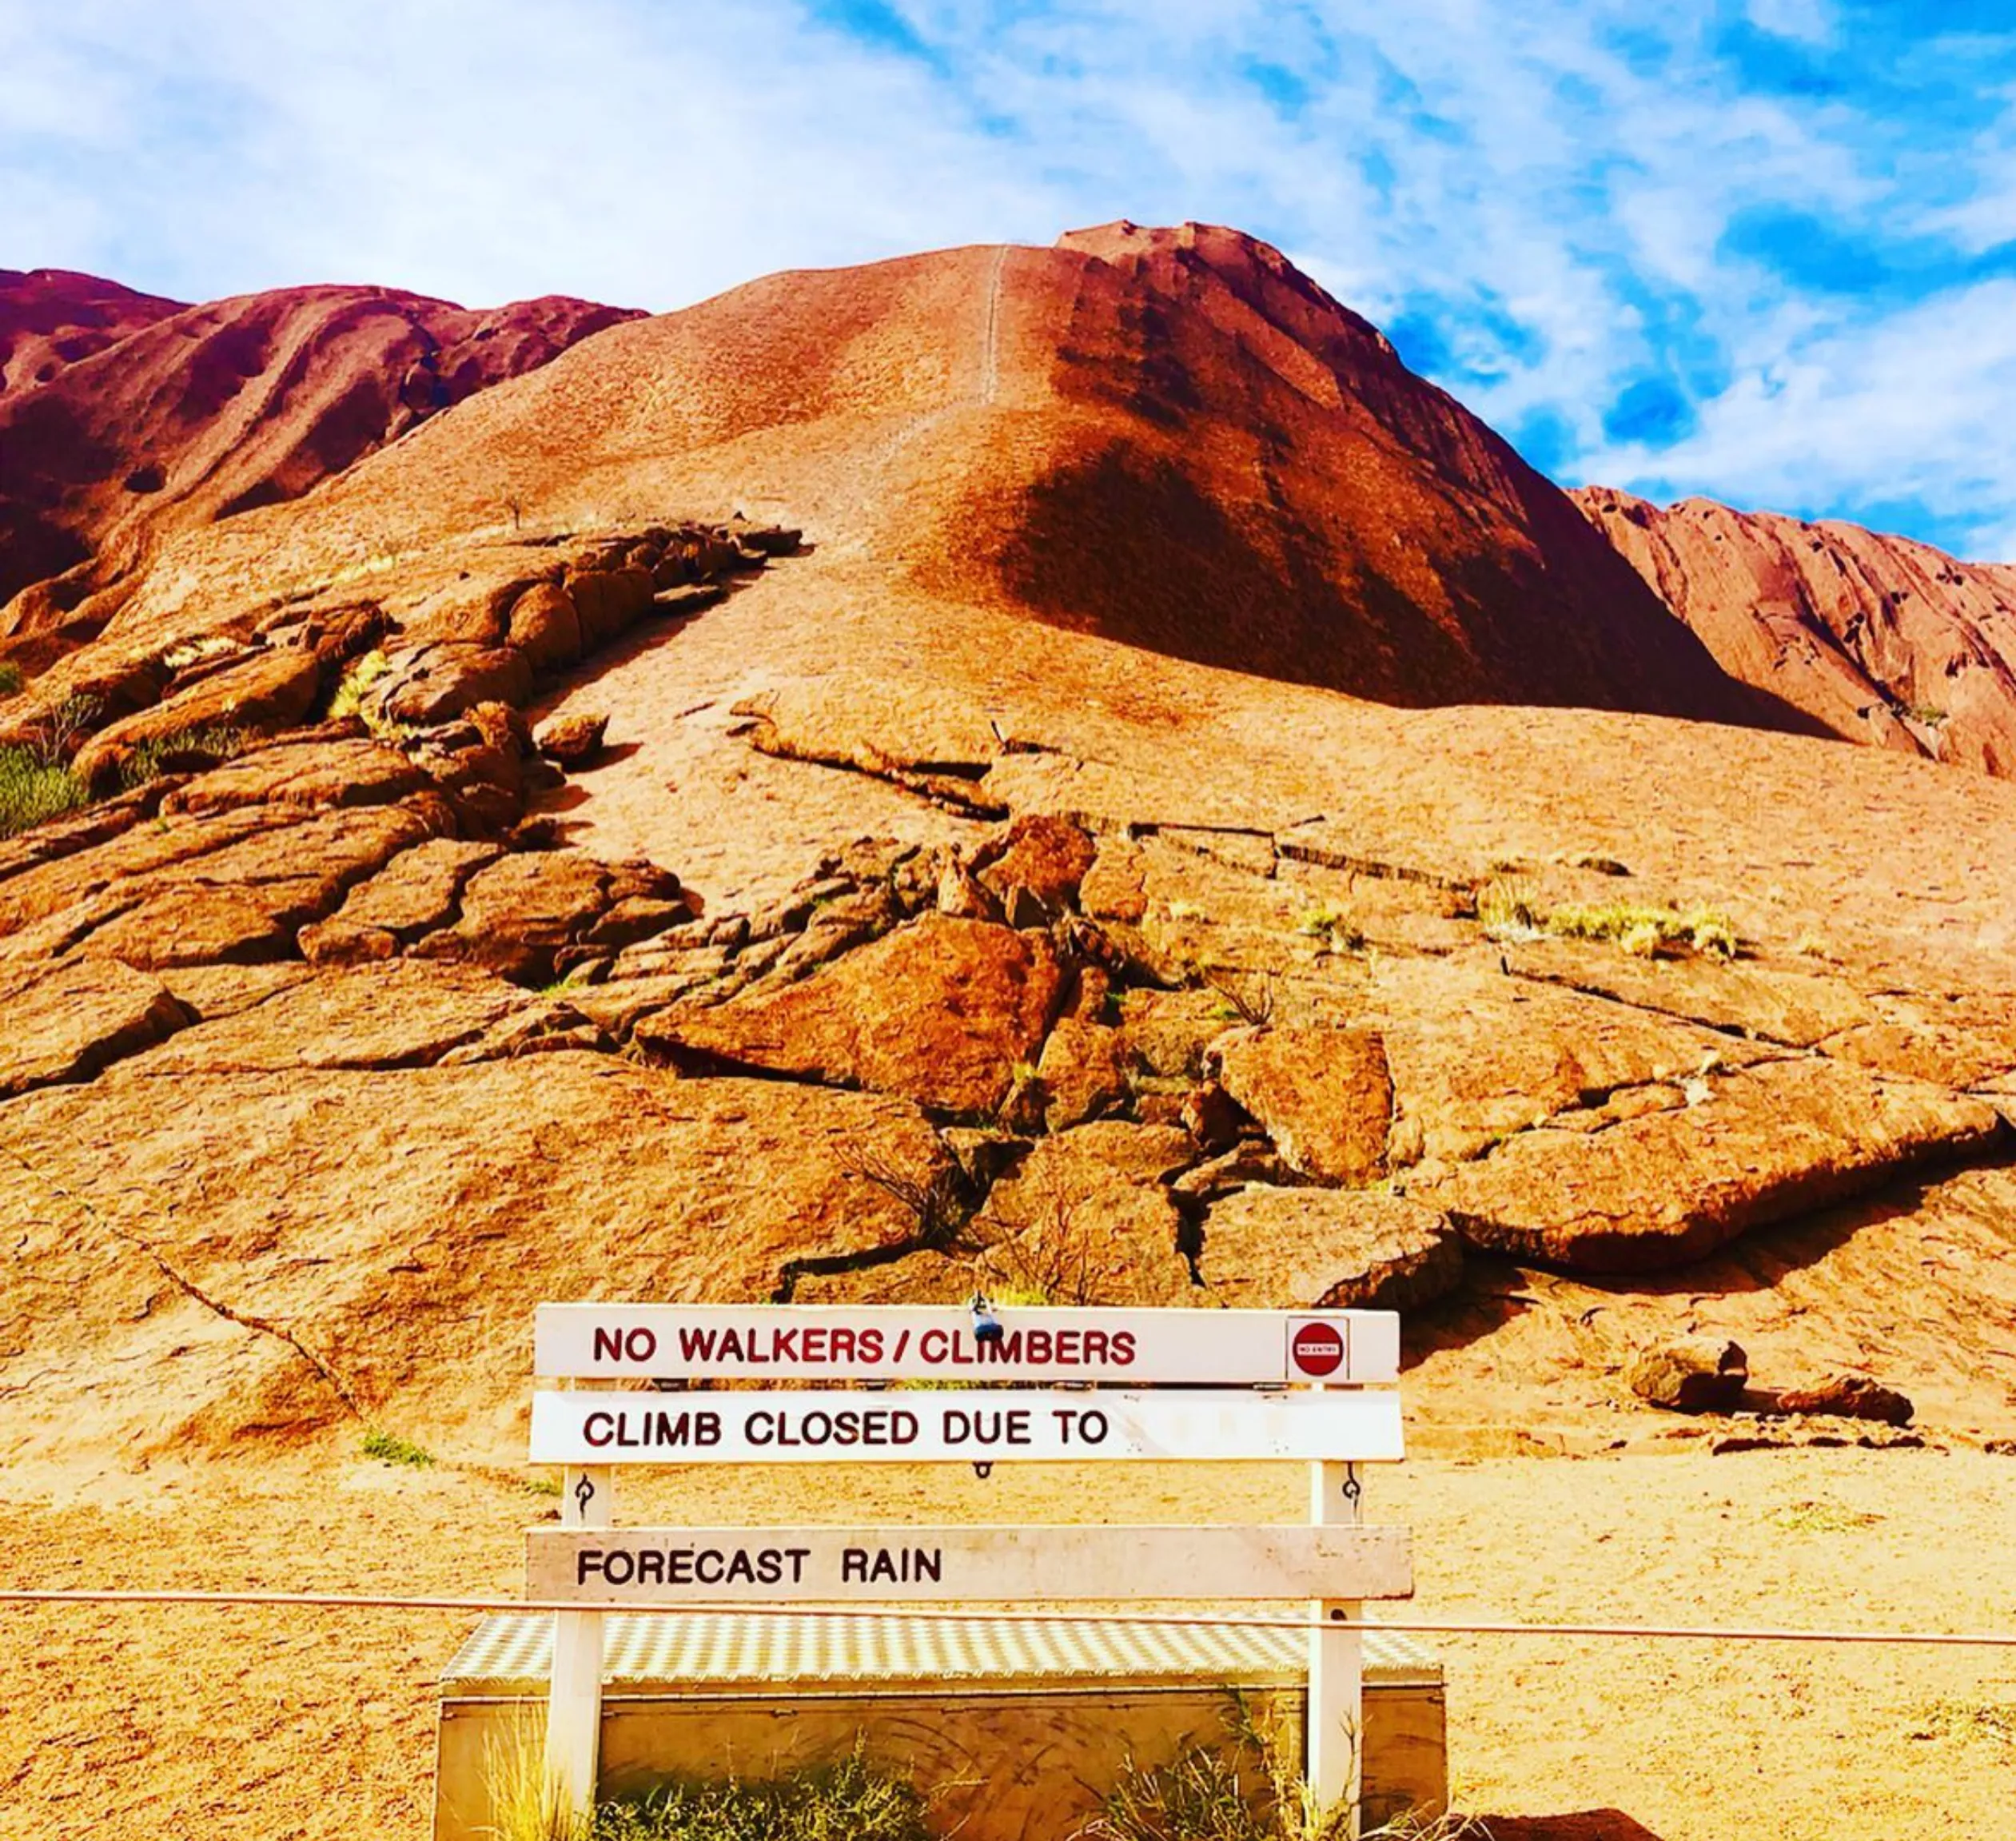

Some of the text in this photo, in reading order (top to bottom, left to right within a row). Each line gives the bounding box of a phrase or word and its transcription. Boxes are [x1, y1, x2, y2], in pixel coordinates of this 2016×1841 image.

[593, 1327, 657, 1362] NO
[583, 1410, 1109, 1447] CLIMB CLOSED DUE TO
[577, 1547, 942, 1586] FORECAST RAIN
